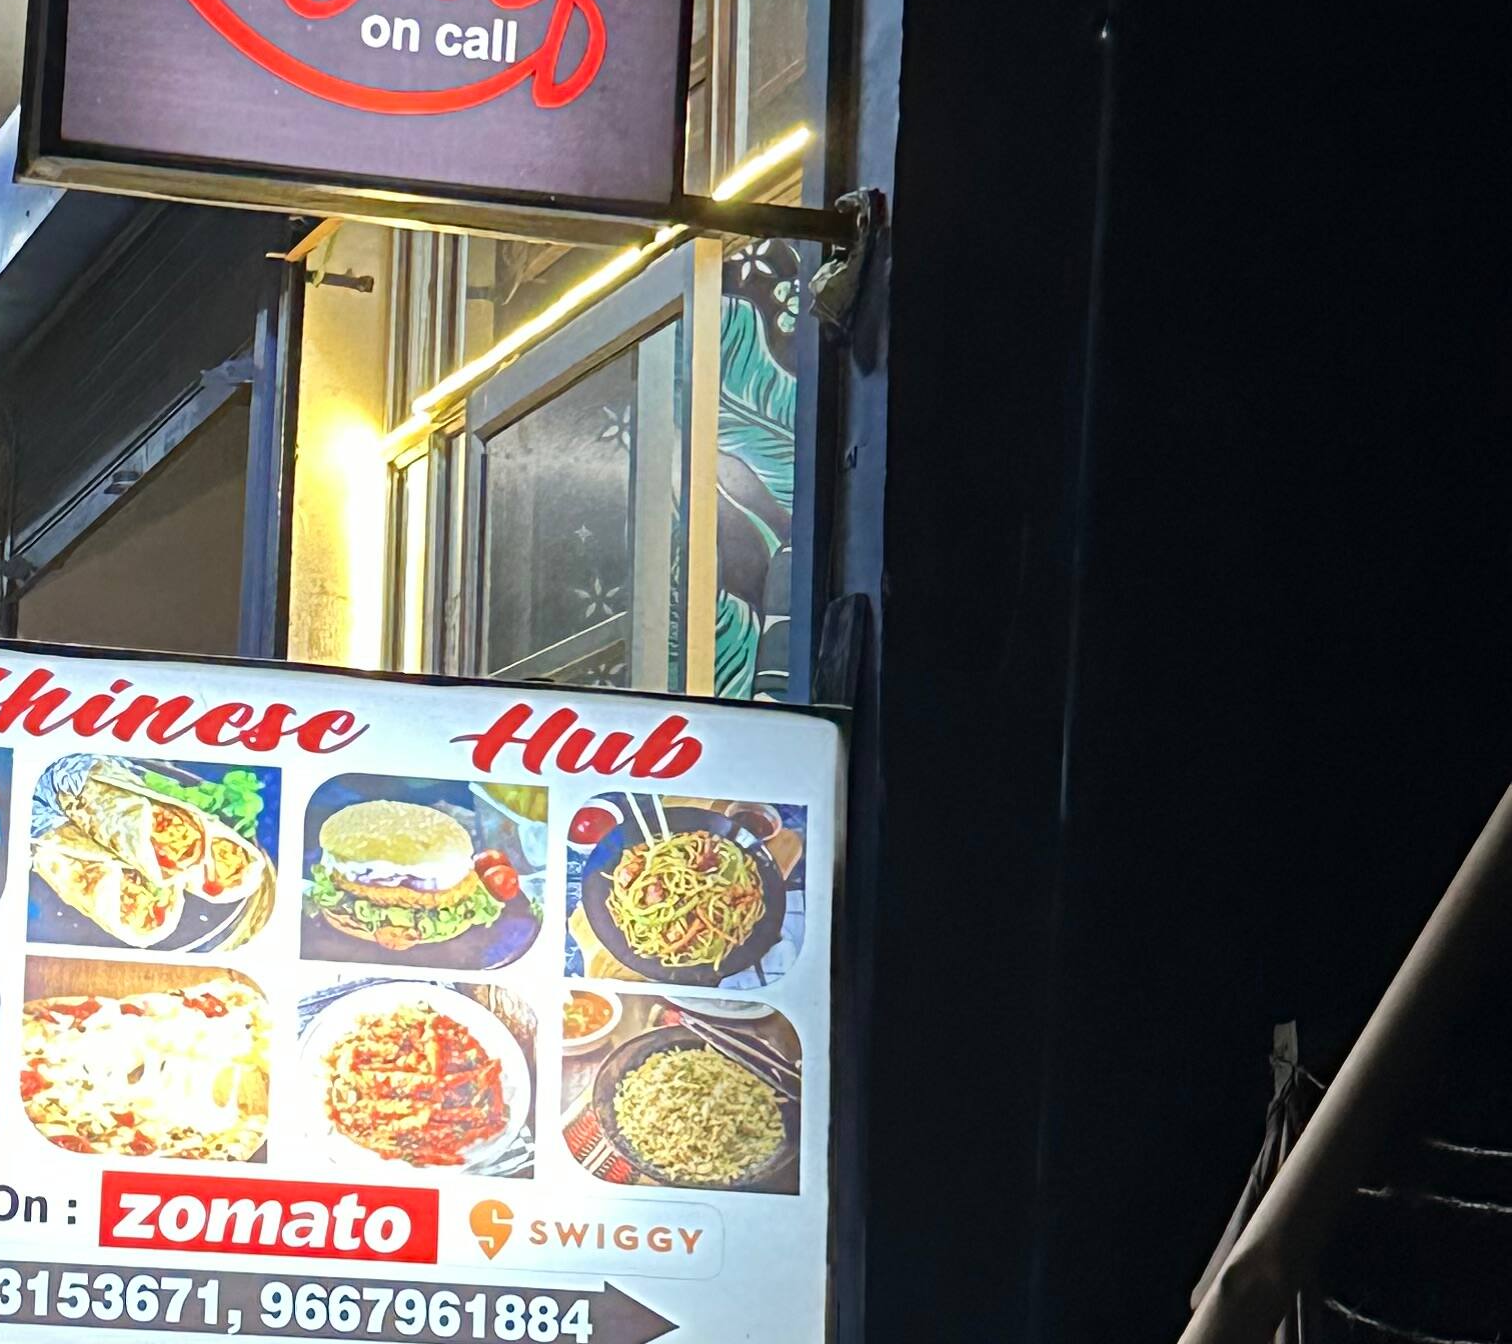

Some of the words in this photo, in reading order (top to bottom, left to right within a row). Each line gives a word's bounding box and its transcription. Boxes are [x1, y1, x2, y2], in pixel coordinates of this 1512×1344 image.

[361, 15, 419, 51] on
[435, 17, 517, 63] call
[449, 703, 703, 779] Hub
[112, 1192, 411, 1253] zomato
[529, 1220, 704, 1255] SWIGGY
[260, 1281, 593, 1344] 9667961884
